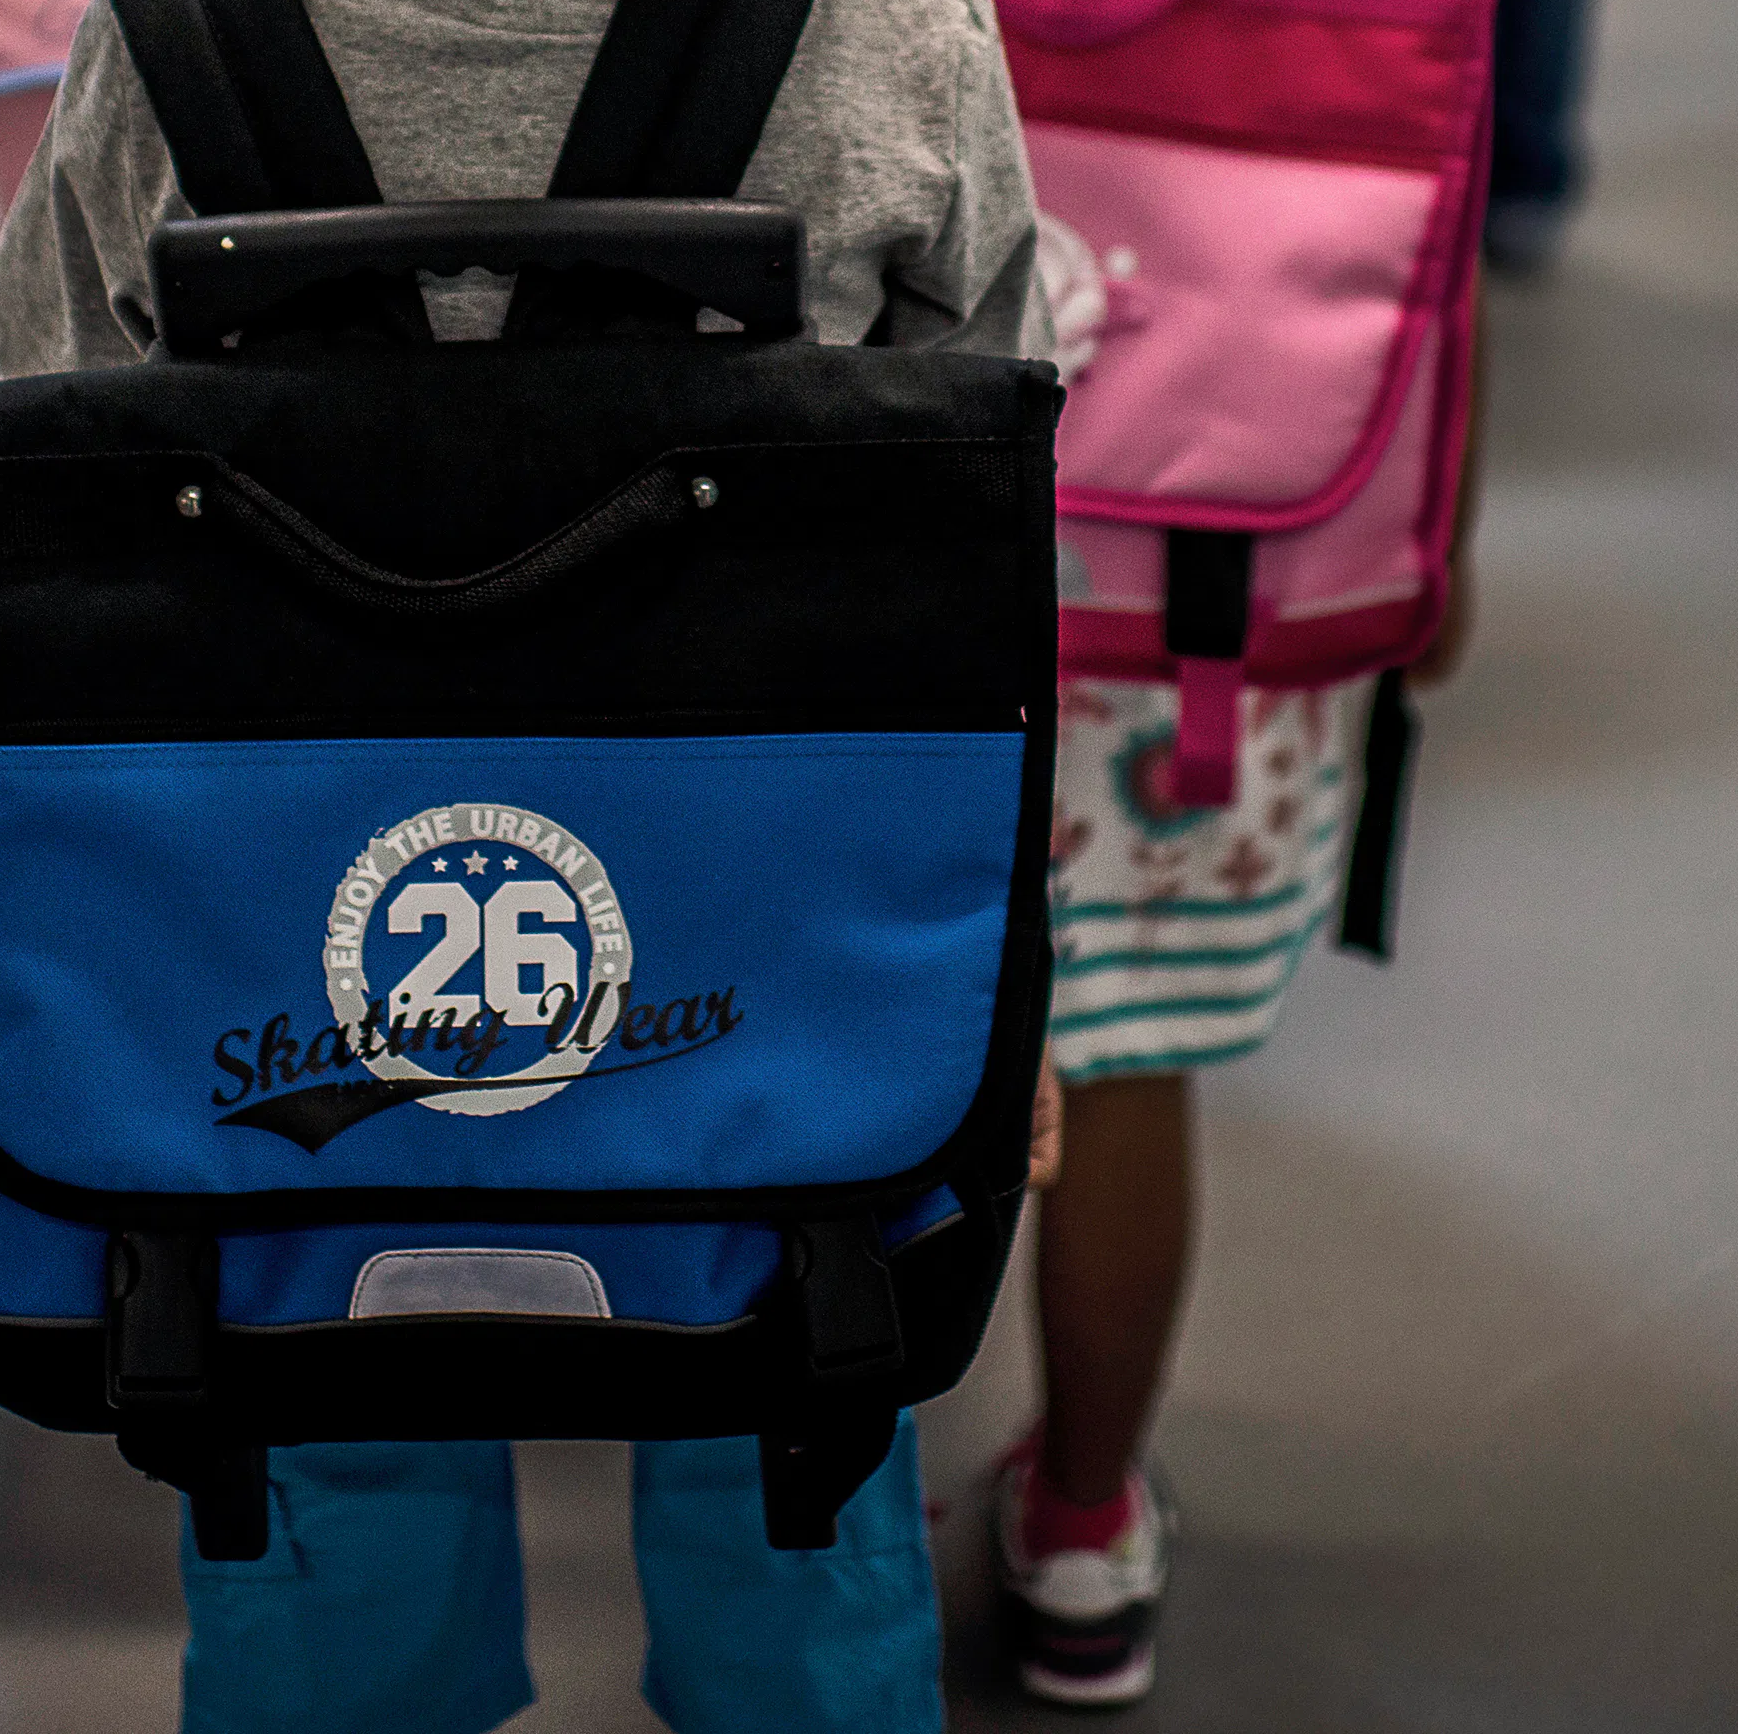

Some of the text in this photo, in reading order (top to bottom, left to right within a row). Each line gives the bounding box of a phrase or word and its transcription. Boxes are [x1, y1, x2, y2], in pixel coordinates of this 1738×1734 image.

[330, 809, 624, 969] ENJOY THE URBAN LIFE
[388, 880, 577, 1029] 26
[212, 980, 745, 1106] Skating Wear
